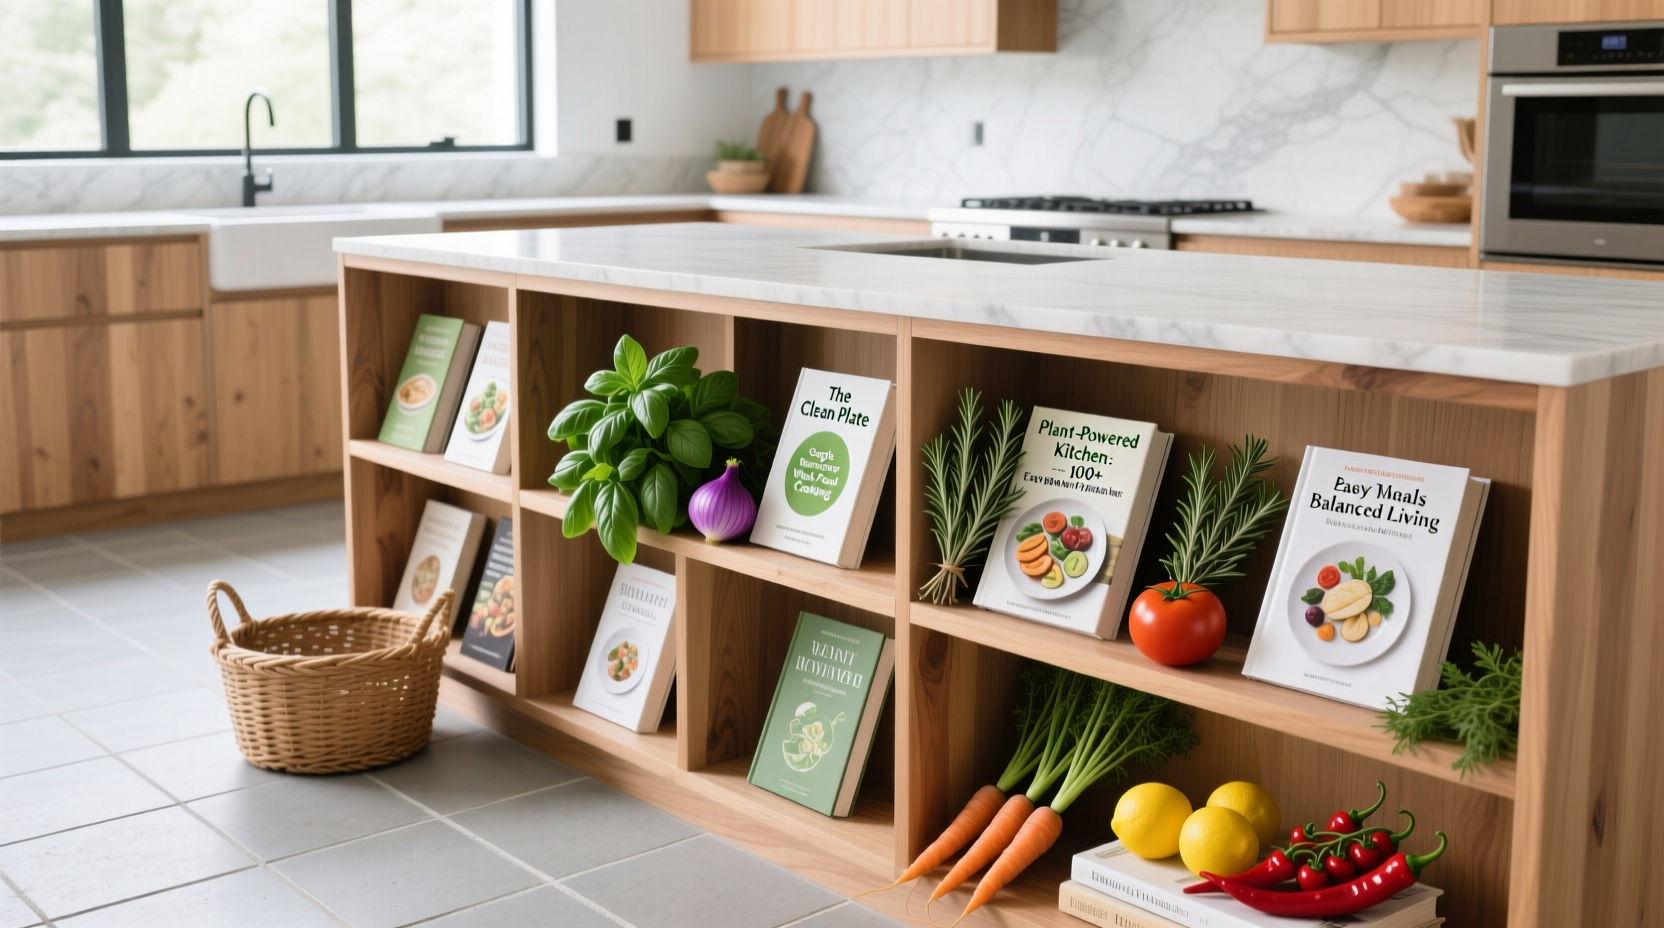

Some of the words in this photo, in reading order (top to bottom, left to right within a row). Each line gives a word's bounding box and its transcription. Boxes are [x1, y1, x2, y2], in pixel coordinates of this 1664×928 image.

[829, 385, 852, 404] The
[800, 400, 835, 421] Clean
[837, 406, 870, 428] Plate
[1038, 419, 1141, 449] Plant-Powered
[1053, 441, 1114, 466] Kitchen:
[1069, 465, 1104, 481] 100+
[1309, 492, 1384, 519] Balanced
[1386, 505, 1441, 535] Living
